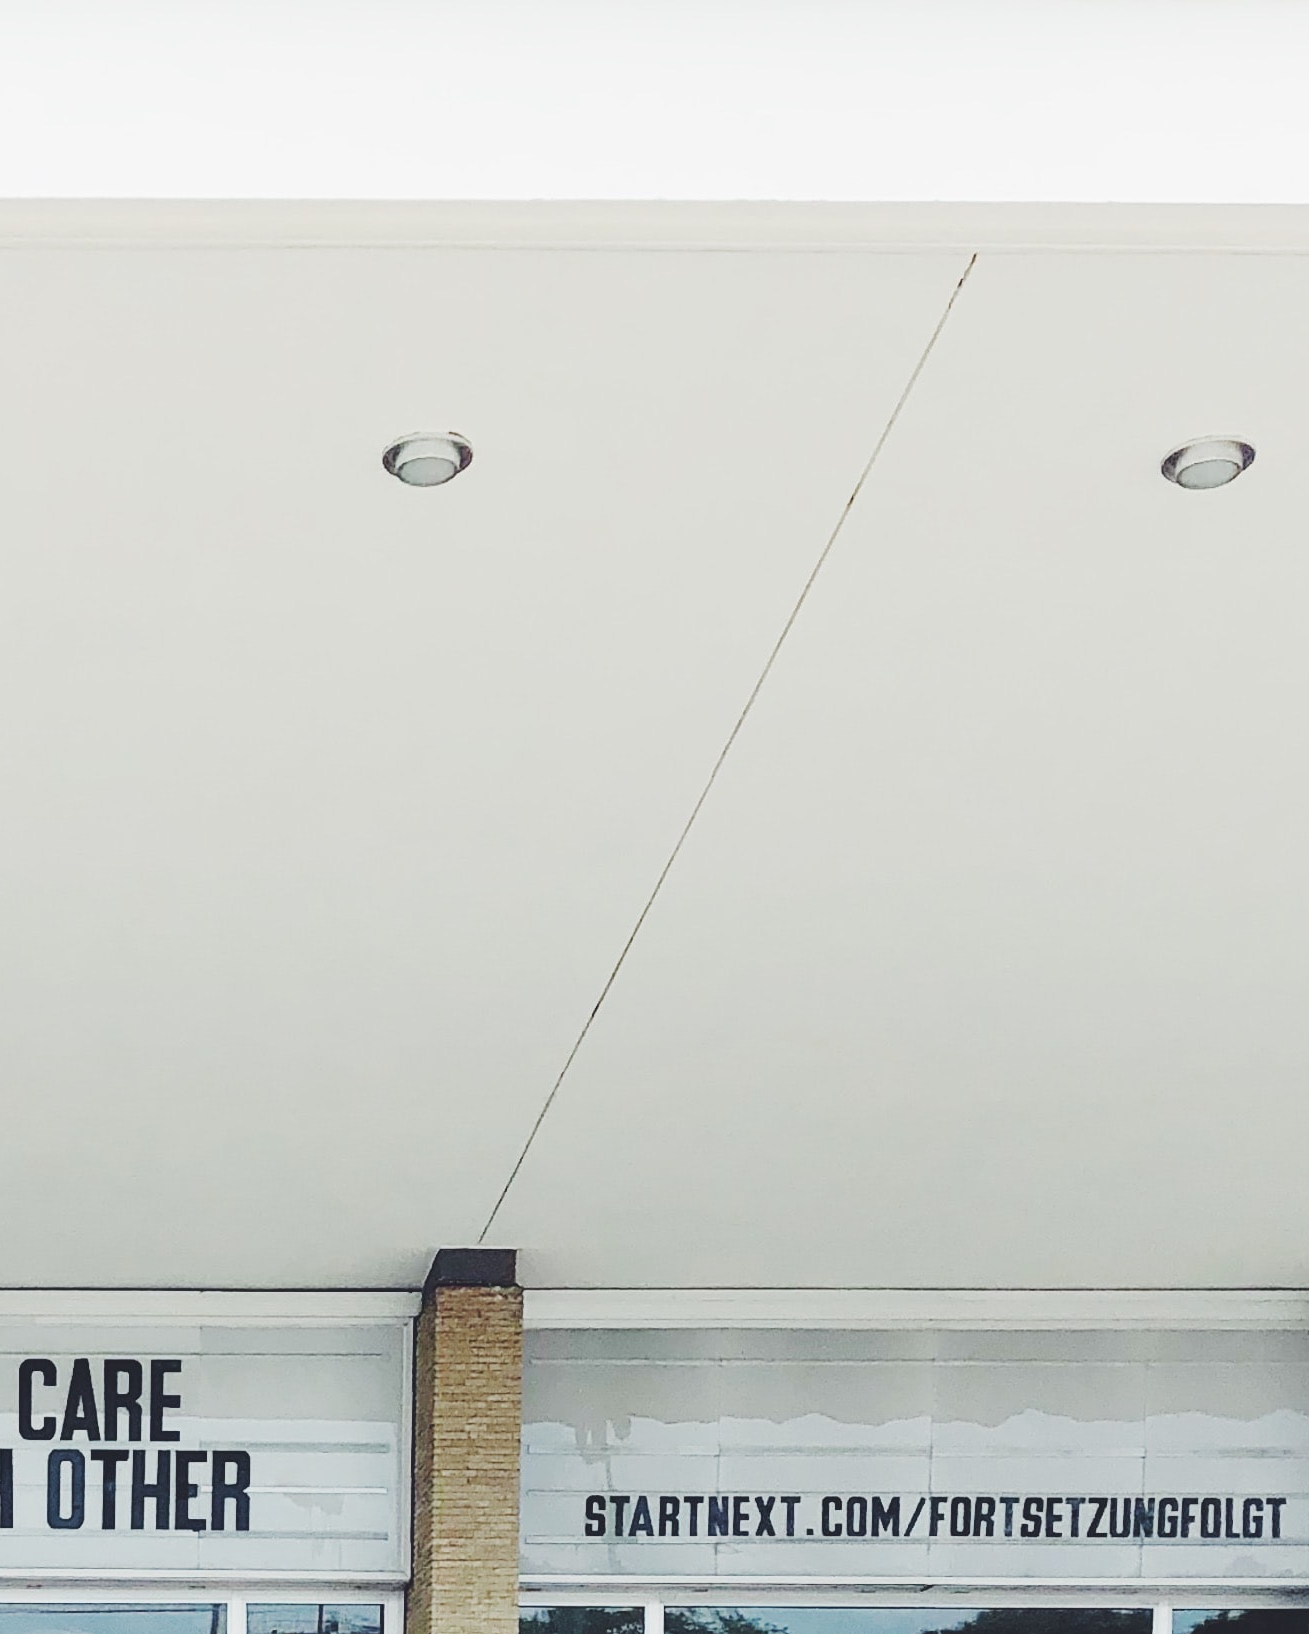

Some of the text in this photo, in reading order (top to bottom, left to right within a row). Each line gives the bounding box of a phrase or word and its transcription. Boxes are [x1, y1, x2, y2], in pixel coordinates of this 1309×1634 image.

[18, 1357, 182, 1442] CARE
[46, 1448, 251, 1532] OTHER
[584, 1494, 1287, 1539] STARTNEXT.COM/FORTSETZUNGFOLGT
